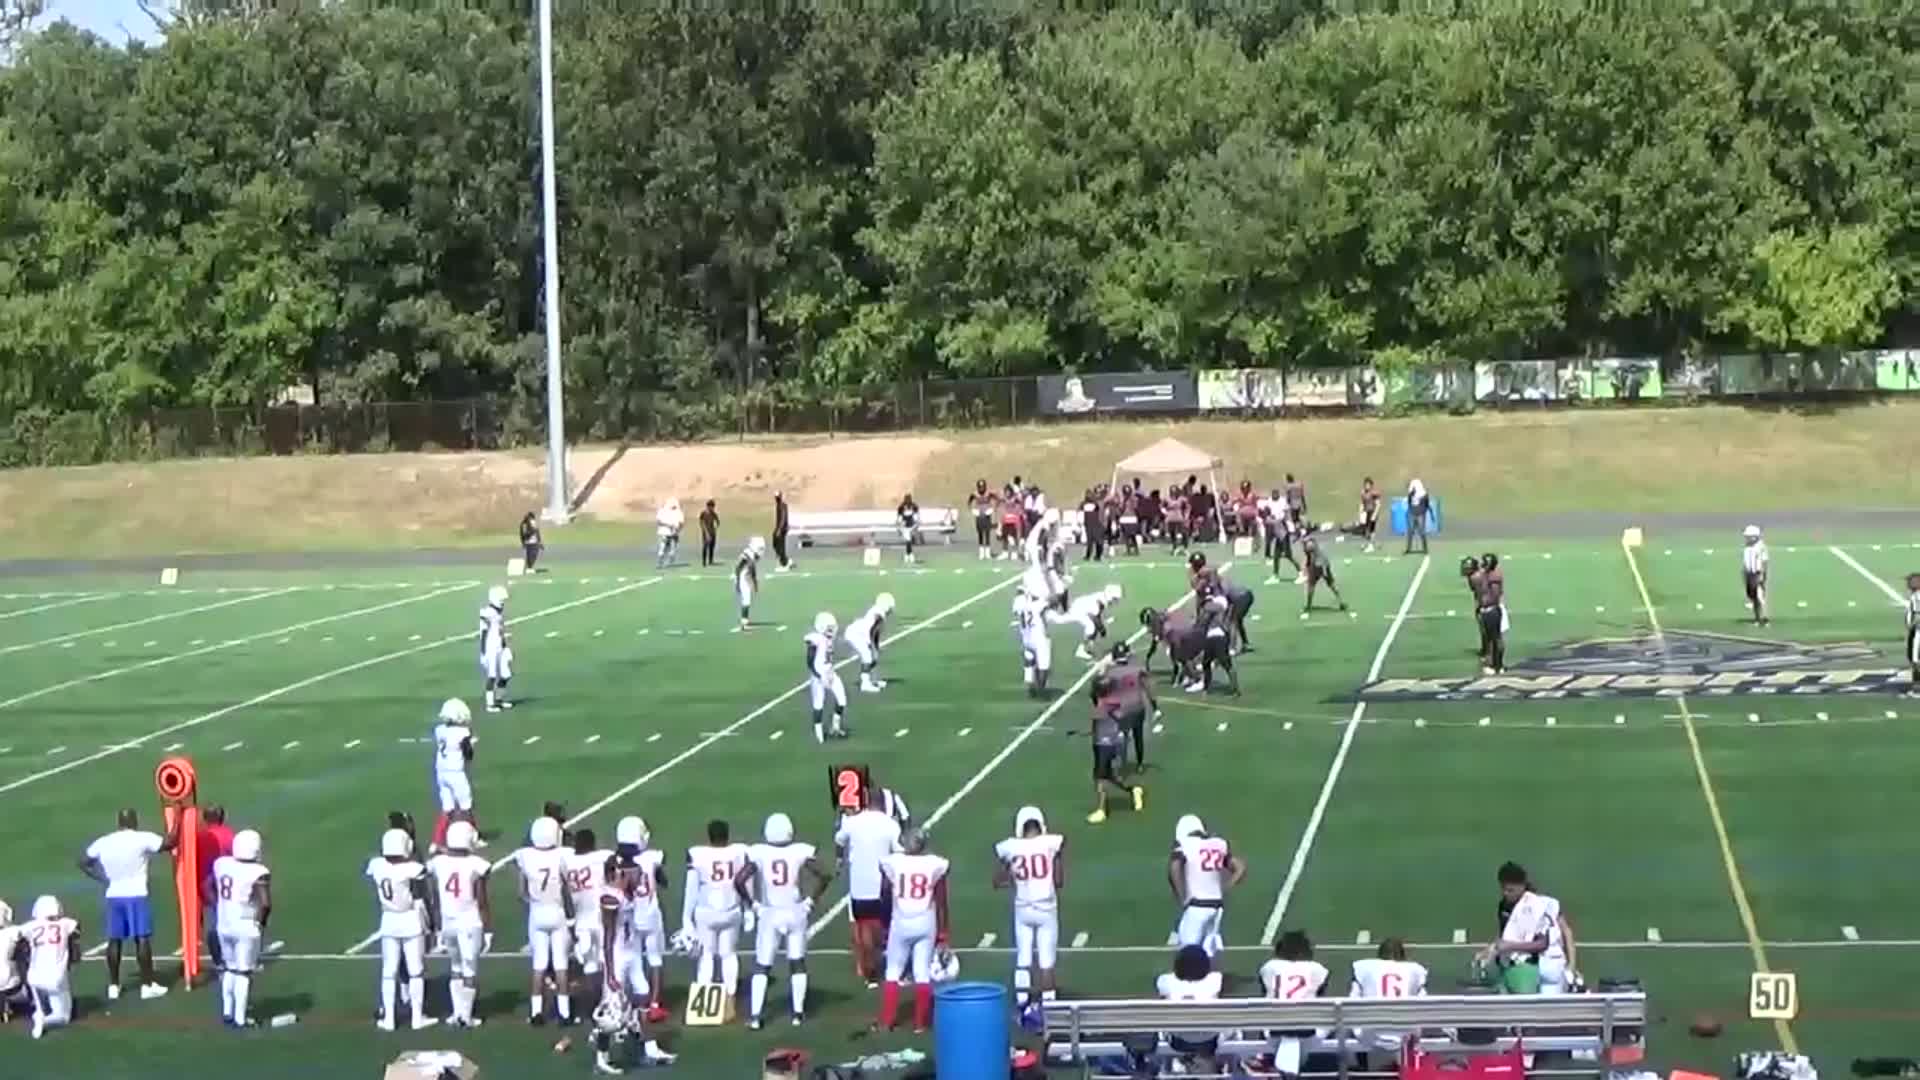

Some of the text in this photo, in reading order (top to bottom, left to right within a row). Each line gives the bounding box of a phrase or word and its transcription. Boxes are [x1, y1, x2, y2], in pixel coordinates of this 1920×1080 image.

[838, 770, 860, 807] 2
[711, 860, 734, 881] 51
[772, 859, 788, 887] 9
[1012, 853, 1048, 881] 30
[1199, 849, 1223, 872] 22
[220, 875, 233, 900] 8
[445, 871, 461, 898] 4
[539, 868, 550, 891] 7
[898, 873, 928, 899] 18
[32, 924, 61, 946] 23
[1275, 974, 1306, 999] 12
[1755, 978, 1790, 1010] 50
[690, 985, 722, 1018] 40
